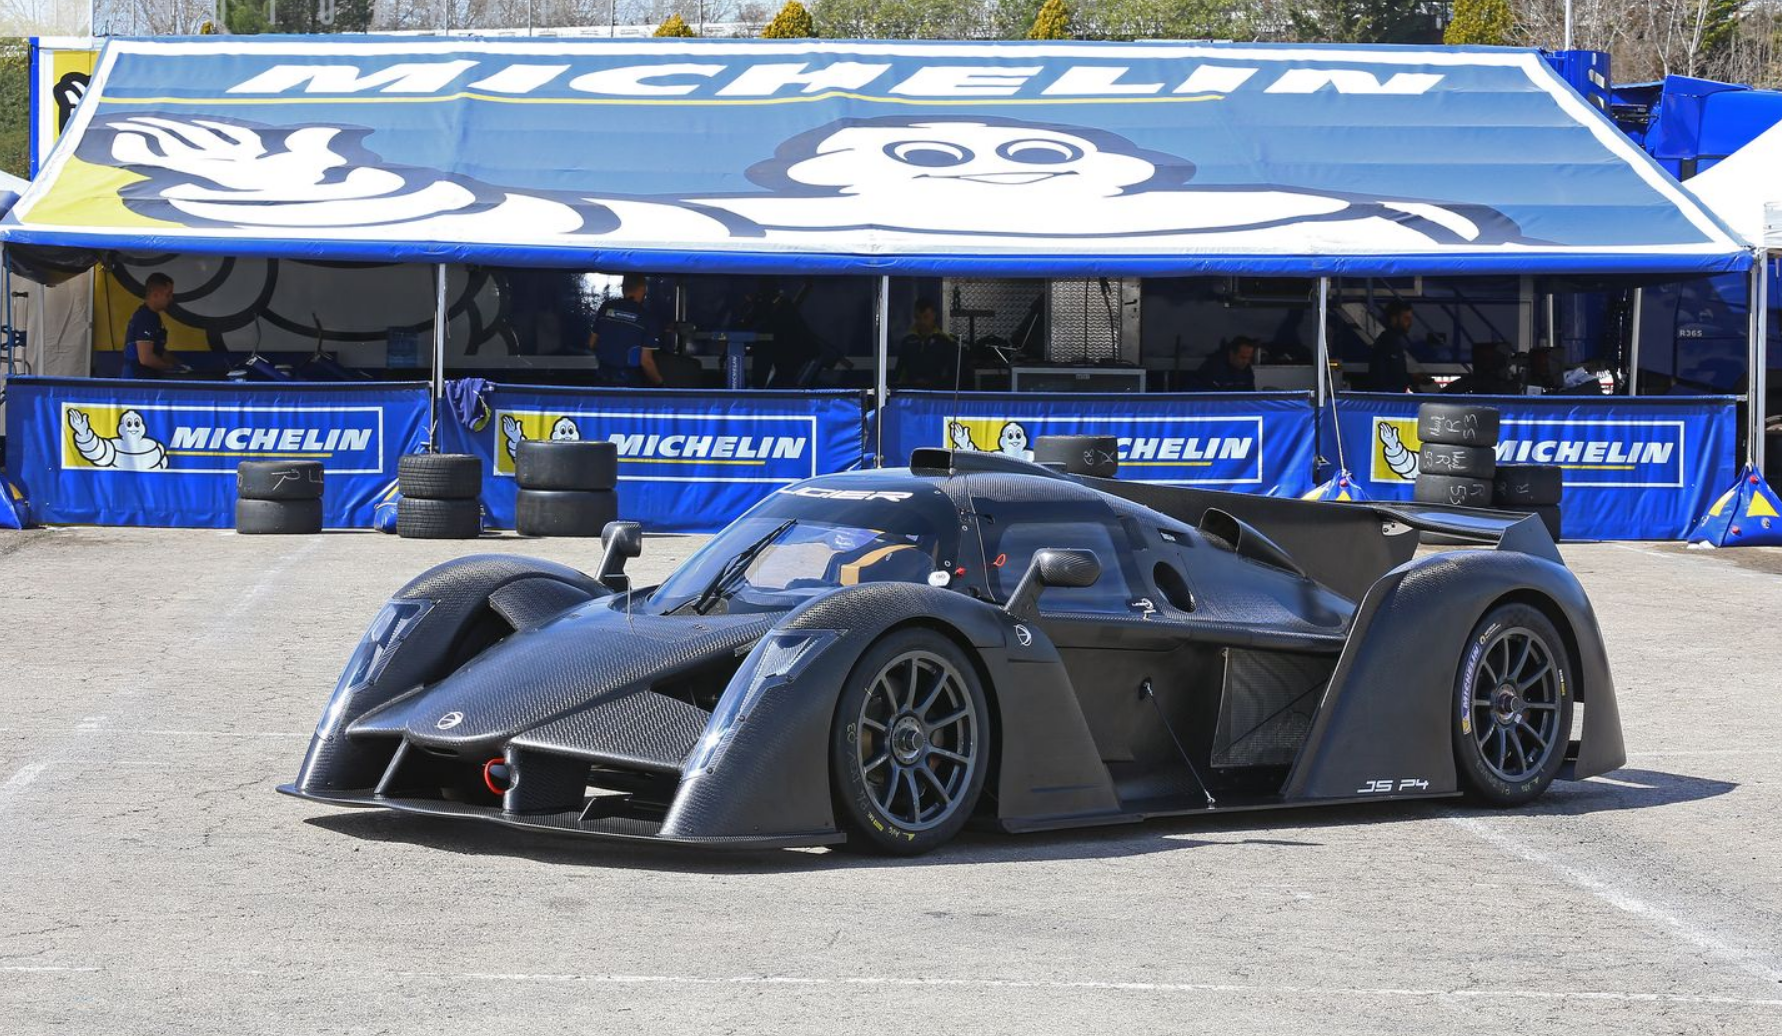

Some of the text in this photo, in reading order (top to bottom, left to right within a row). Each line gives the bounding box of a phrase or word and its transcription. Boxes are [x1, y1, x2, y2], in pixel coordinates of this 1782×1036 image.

[225, 59, 1446, 96] MICHELIN
[170, 427, 372, 452] MICHELIN
[607, 433, 807, 459] MICHELIN
[1116, 437, 1252, 460] CHELIN
[1463, 645, 1480, 710] MICHELIN
[1357, 778, 1430, 793] JS P4
